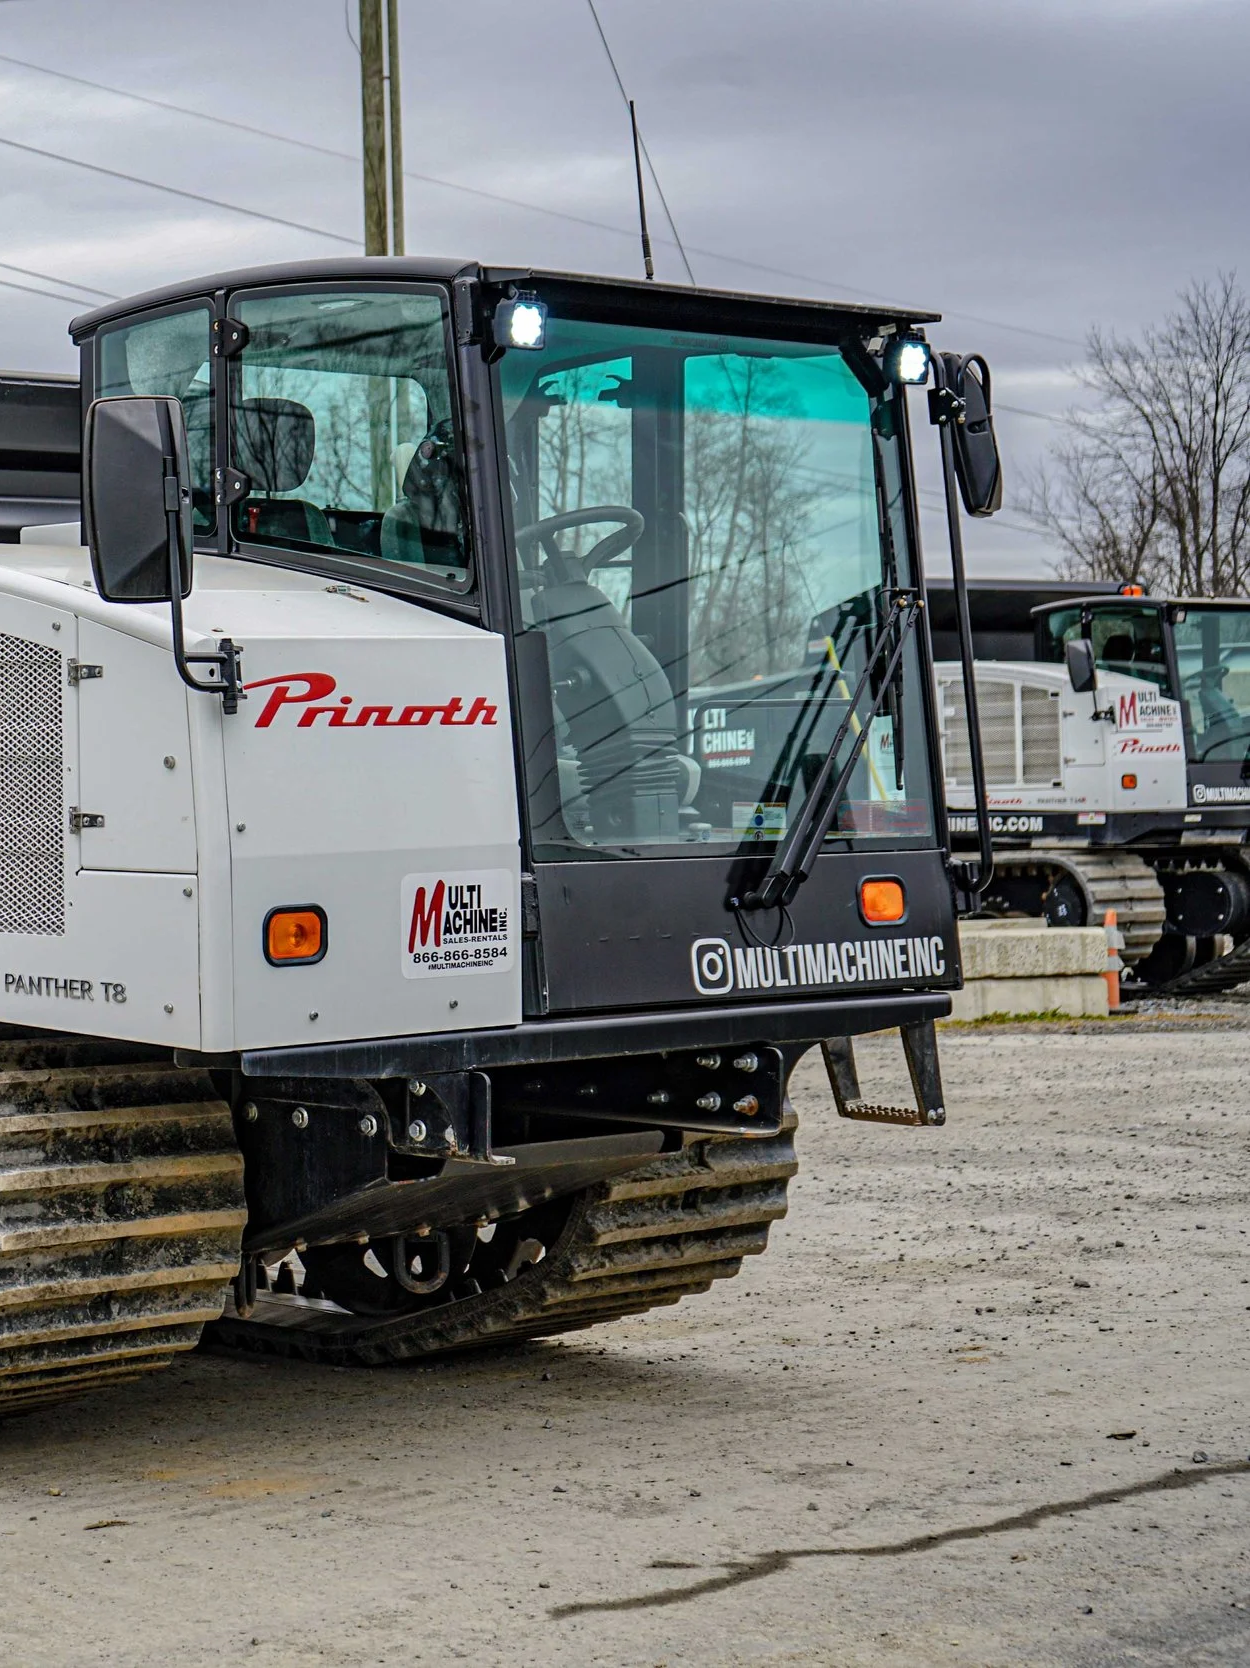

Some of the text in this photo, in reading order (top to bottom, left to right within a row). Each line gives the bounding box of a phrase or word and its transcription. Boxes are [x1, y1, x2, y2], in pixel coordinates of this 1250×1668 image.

[243, 672, 498, 728] Prinoth
[1117, 738, 1180, 754] Prinoth
[499, 907, 508, 932] INC.
[442, 933, 508, 945] SALES-RENTALS
[412, 946, 508, 964] 866-866-8584
[428, 959, 494, 971] #MULTIMACHINEINC
[733, 935, 946, 990] MULTIMACHINEINC
[4, 973, 127, 1004] PANTHER T8
